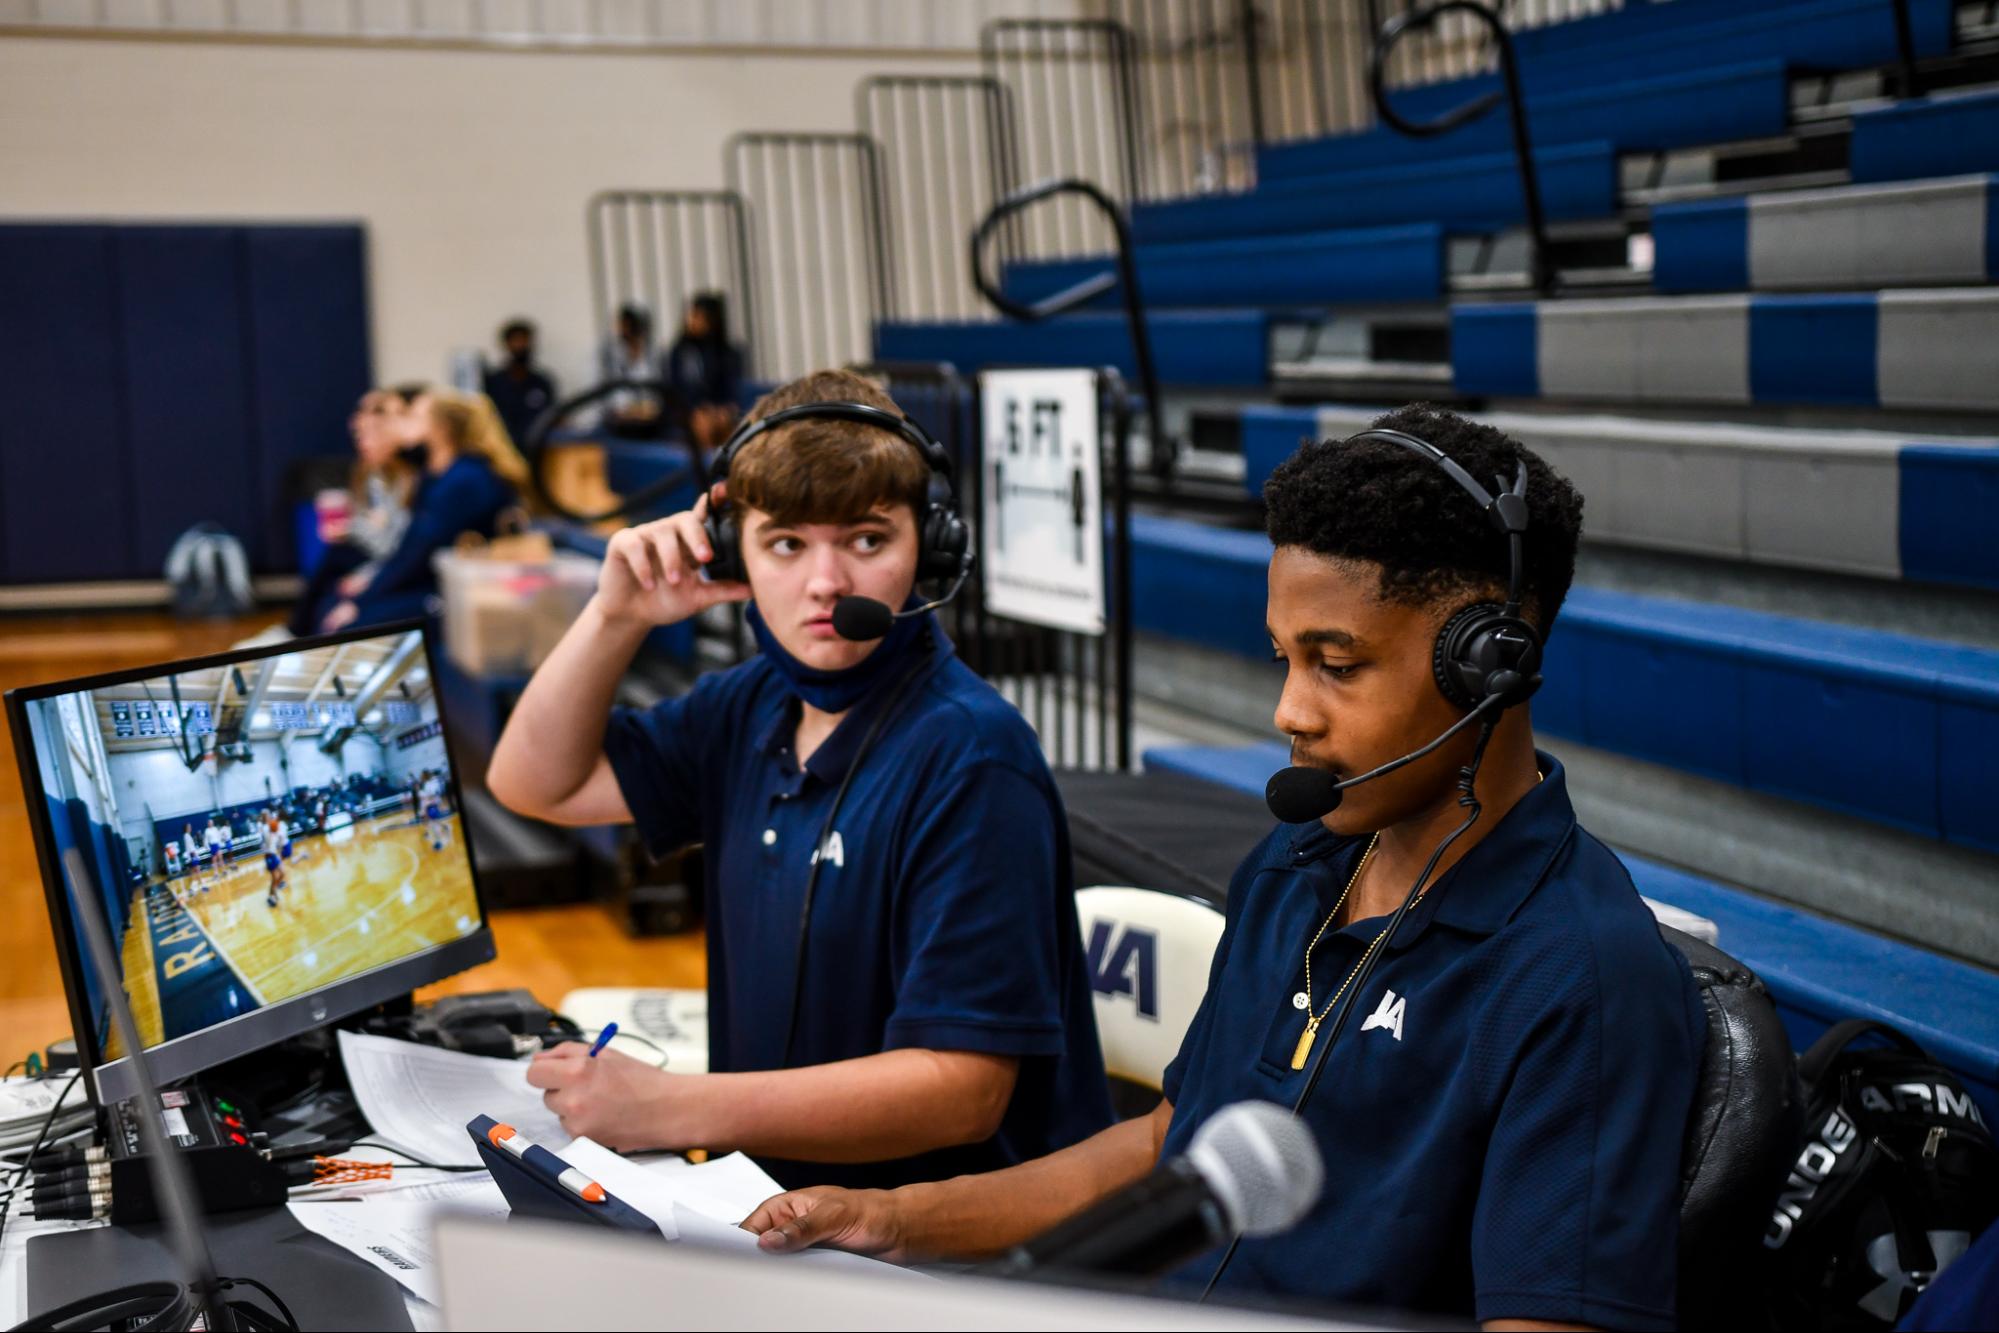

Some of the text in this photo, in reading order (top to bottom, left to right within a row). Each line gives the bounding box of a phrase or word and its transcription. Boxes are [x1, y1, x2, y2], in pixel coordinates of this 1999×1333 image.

[1031, 398, 1062, 458] FT
[1763, 1083, 1989, 1250] UNDE ARM
